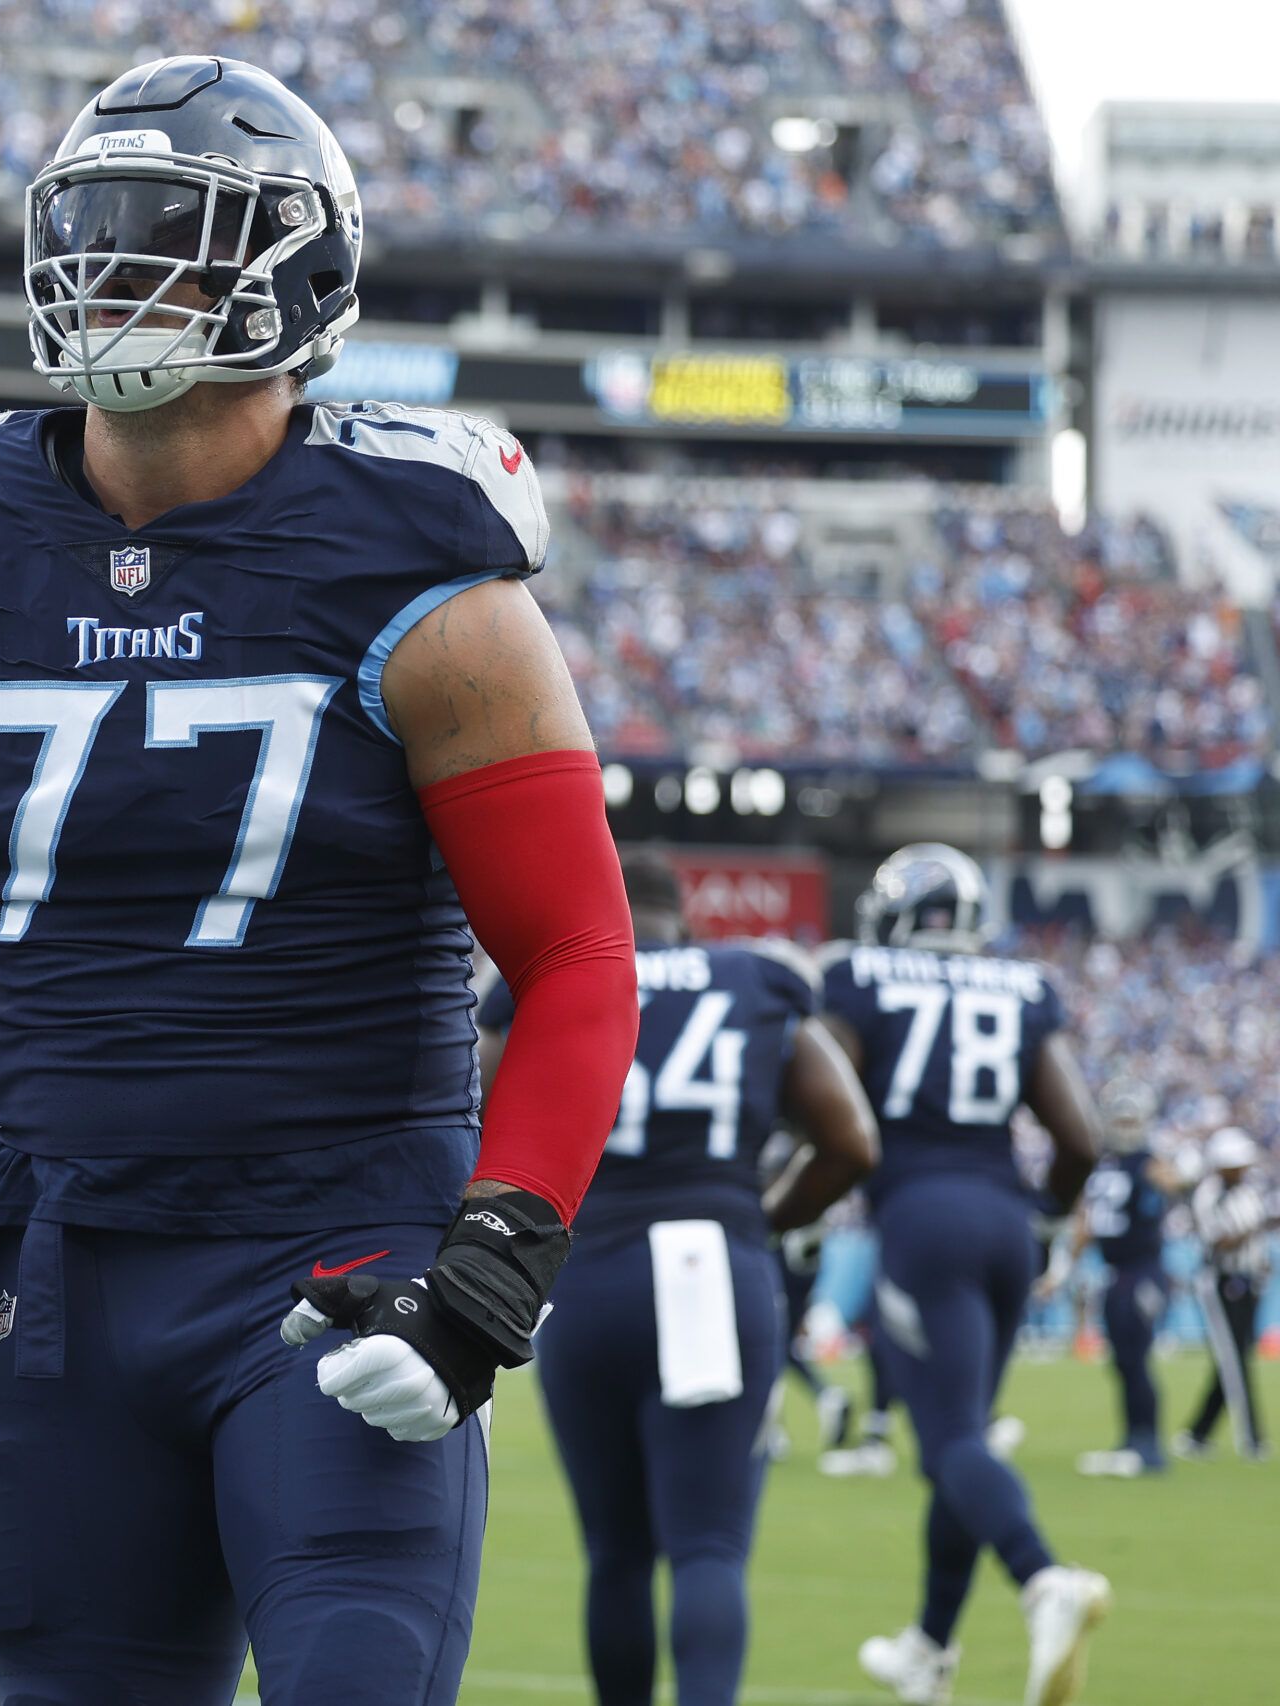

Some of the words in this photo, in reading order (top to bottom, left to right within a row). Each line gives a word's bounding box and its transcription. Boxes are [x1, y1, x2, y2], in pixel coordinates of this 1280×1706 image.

[99, 133, 147, 151] TITANS
[116, 566, 144, 587] NFL
[66, 611, 204, 669] TITANS
[877, 983, 1023, 1125] 78
[464, 1211, 517, 1236] DONJOY
